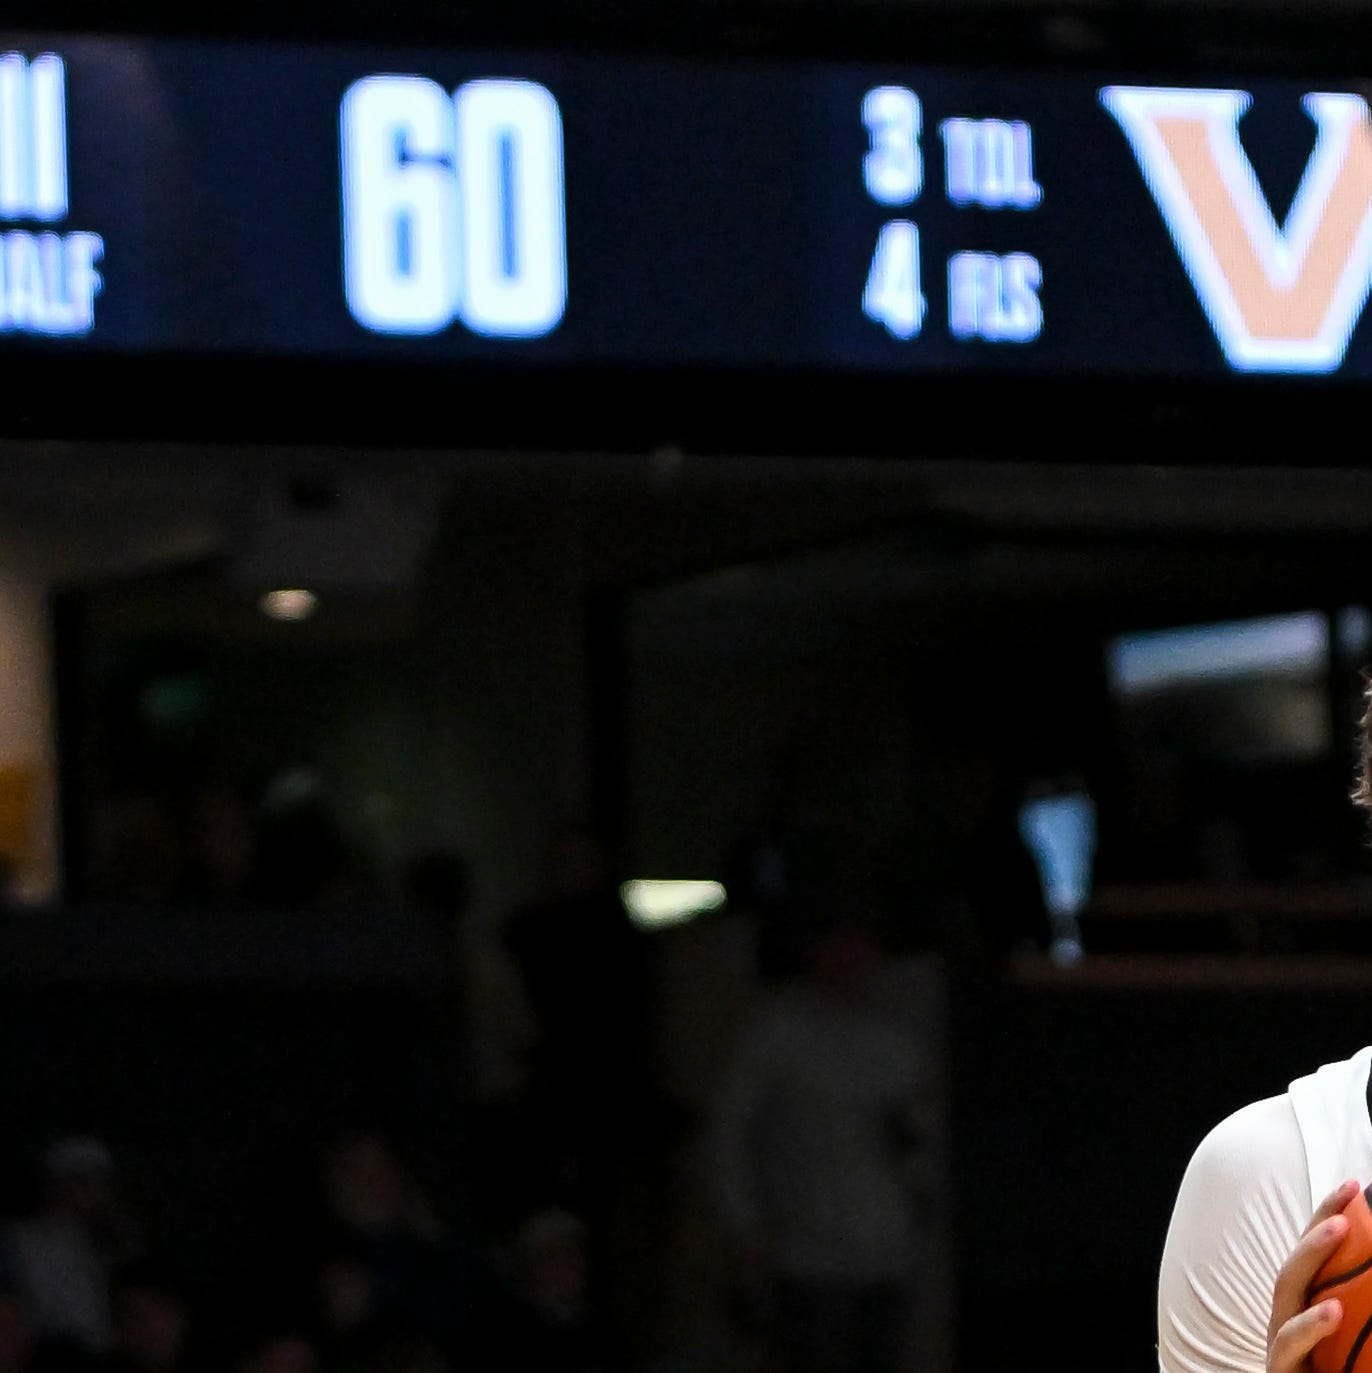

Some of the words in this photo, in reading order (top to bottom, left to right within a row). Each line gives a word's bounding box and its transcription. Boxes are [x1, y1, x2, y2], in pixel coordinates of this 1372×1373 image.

[340, 73, 567, 338] 60
[861, 85, 923, 206] 3
[0, 229, 104, 337] ALF
[861, 219, 928, 340] 4
[947, 250, 1044, 343] FLS
